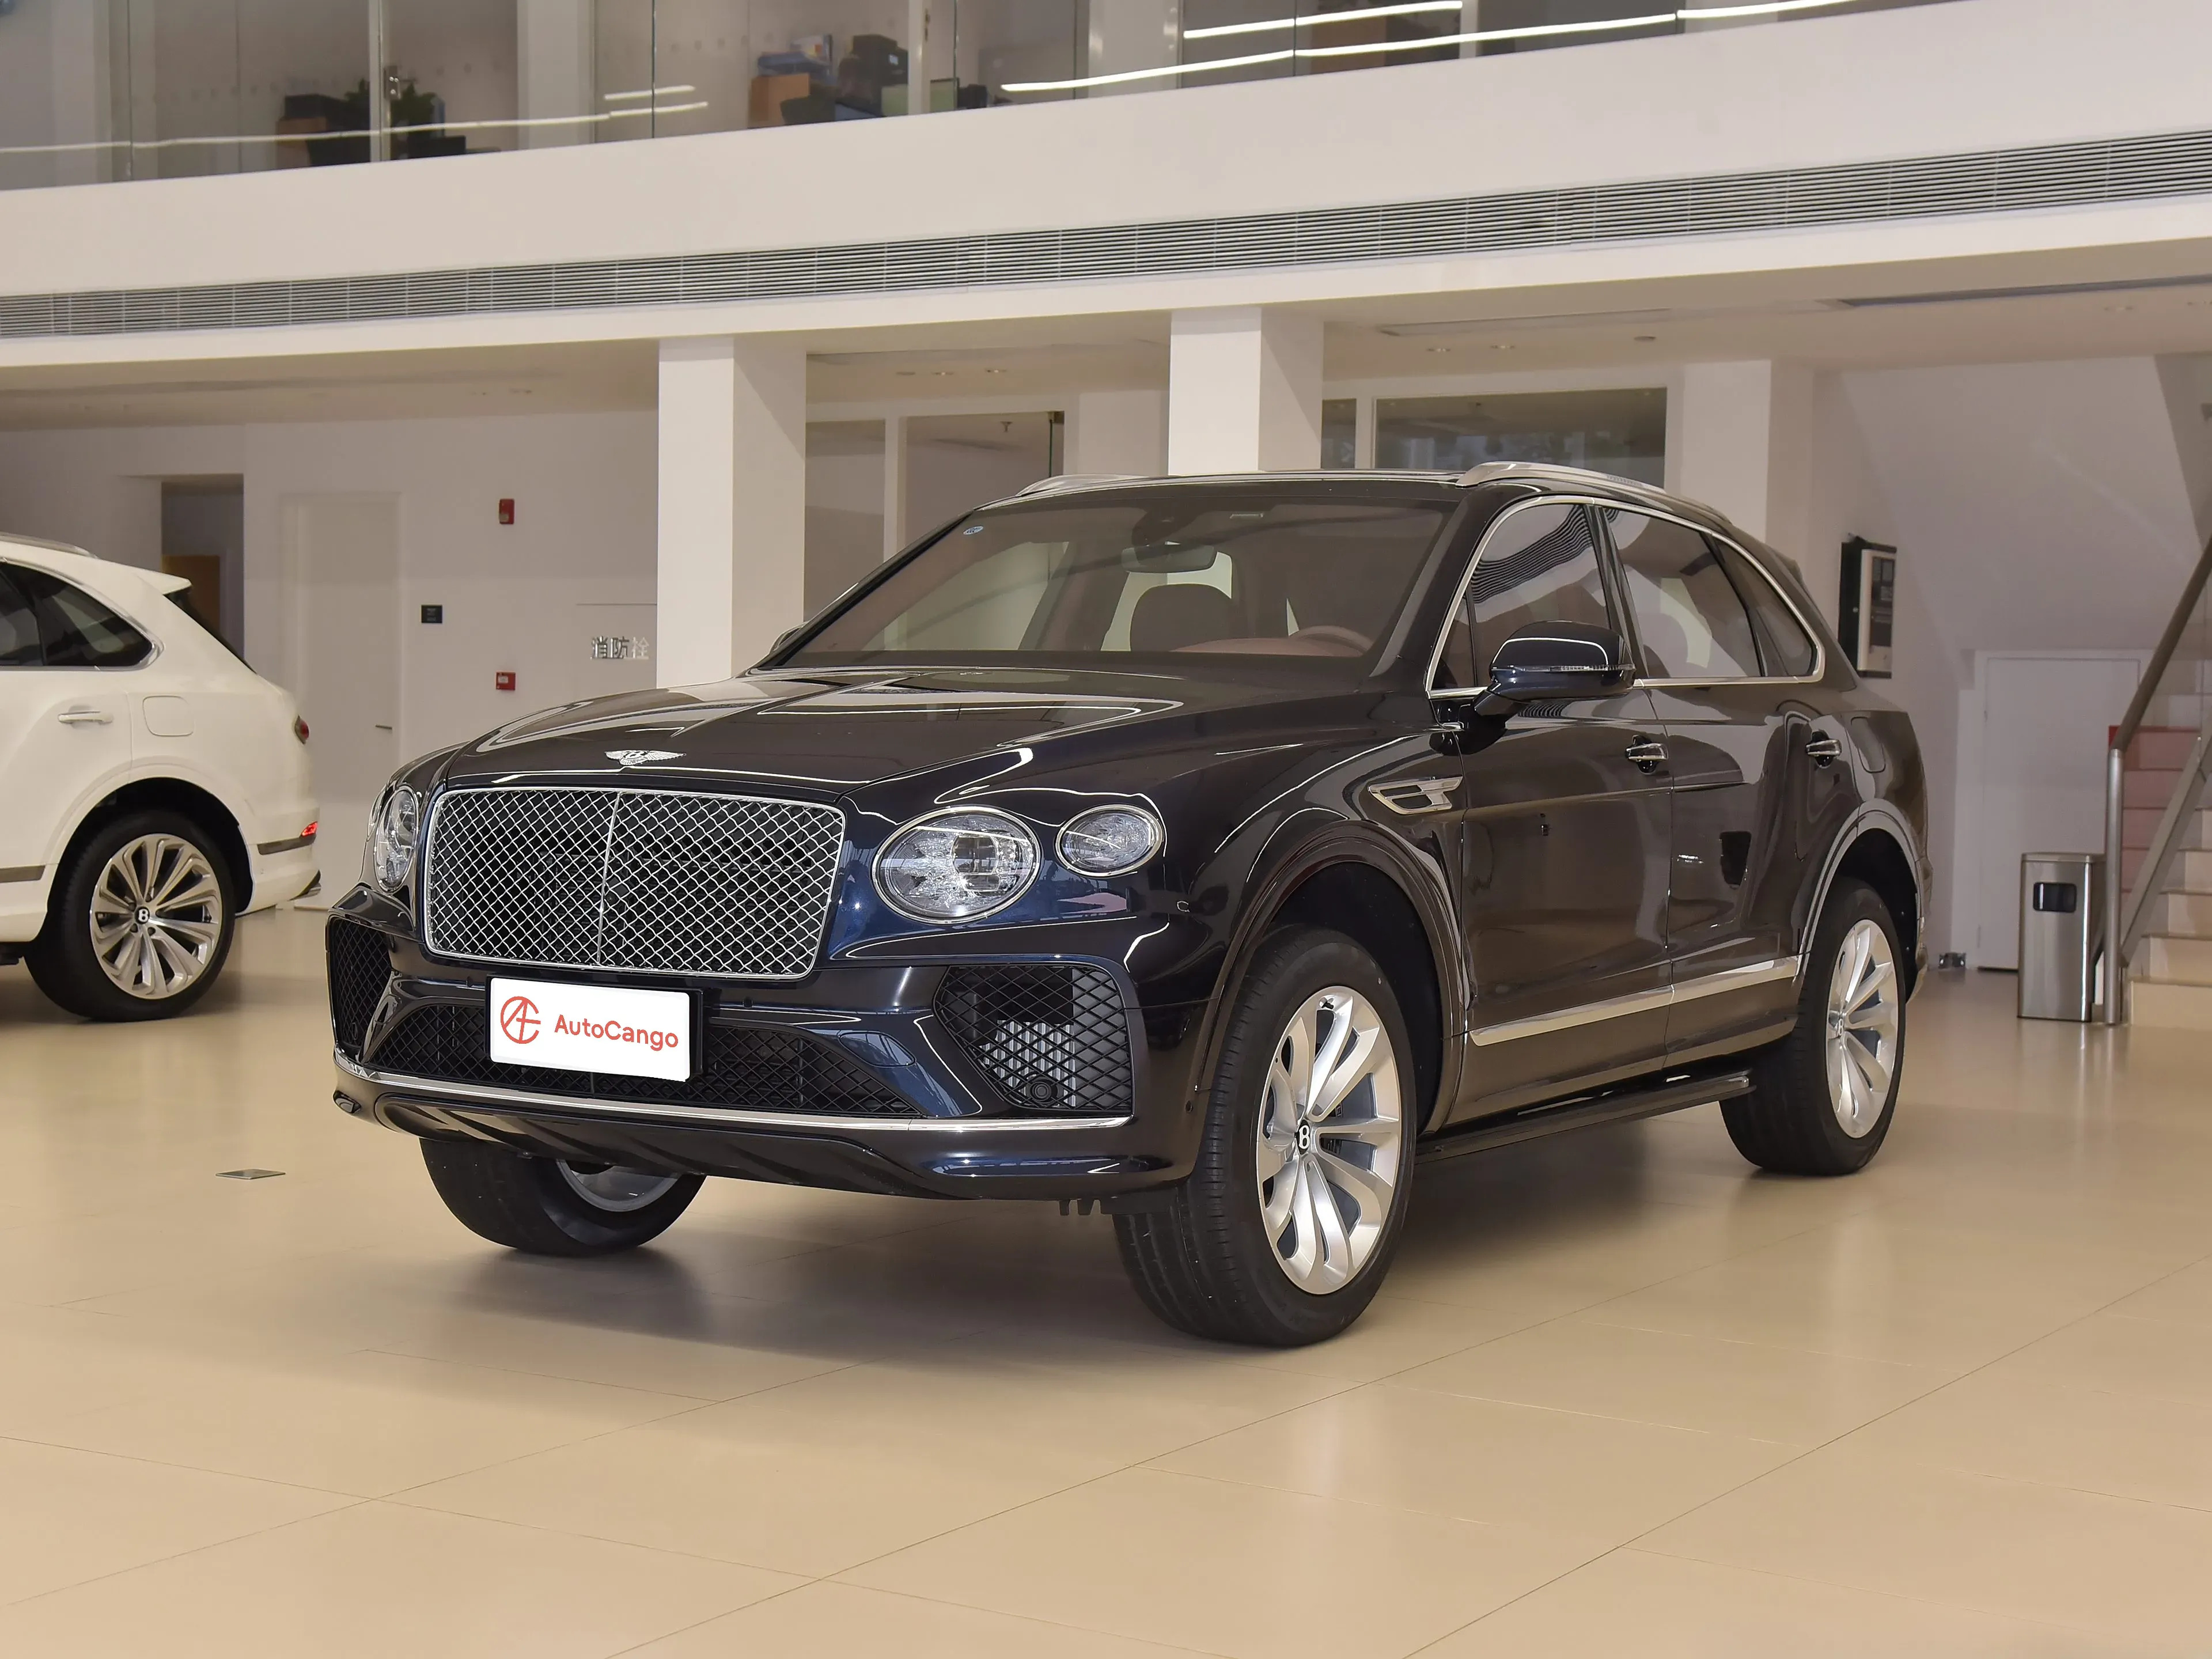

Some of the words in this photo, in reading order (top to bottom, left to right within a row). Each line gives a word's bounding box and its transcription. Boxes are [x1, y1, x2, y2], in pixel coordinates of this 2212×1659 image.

[590, 636, 650, 661] 消防栓
[138, 908, 149, 922] B
[1298, 1125, 1310, 1149] B
